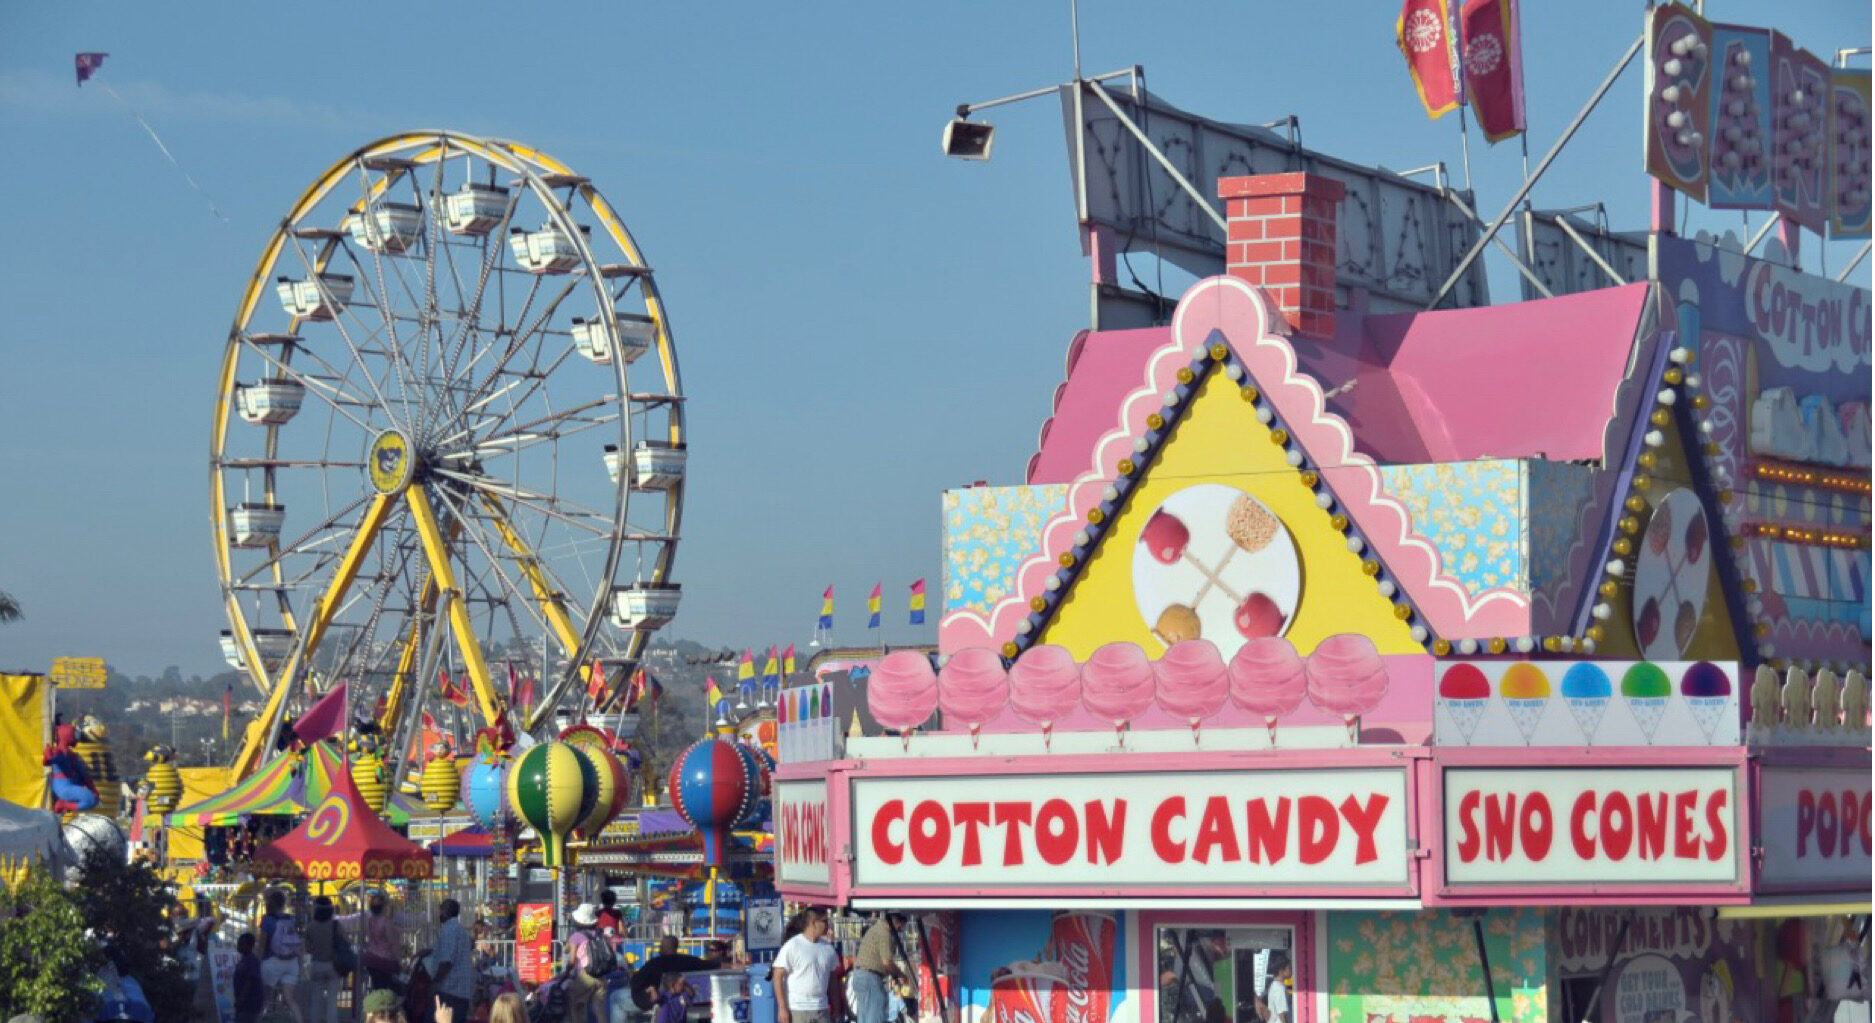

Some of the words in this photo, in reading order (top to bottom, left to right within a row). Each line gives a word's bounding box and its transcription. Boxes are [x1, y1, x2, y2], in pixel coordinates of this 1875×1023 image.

[1755, 264, 1842, 356] COTTON
[801, 801, 828, 865] CONE
[872, 799, 1128, 867] COTTON
[1151, 793, 1390, 867] CANDY
[1458, 790, 1554, 863] SNO
[1570, 788, 1728, 863] CONES
